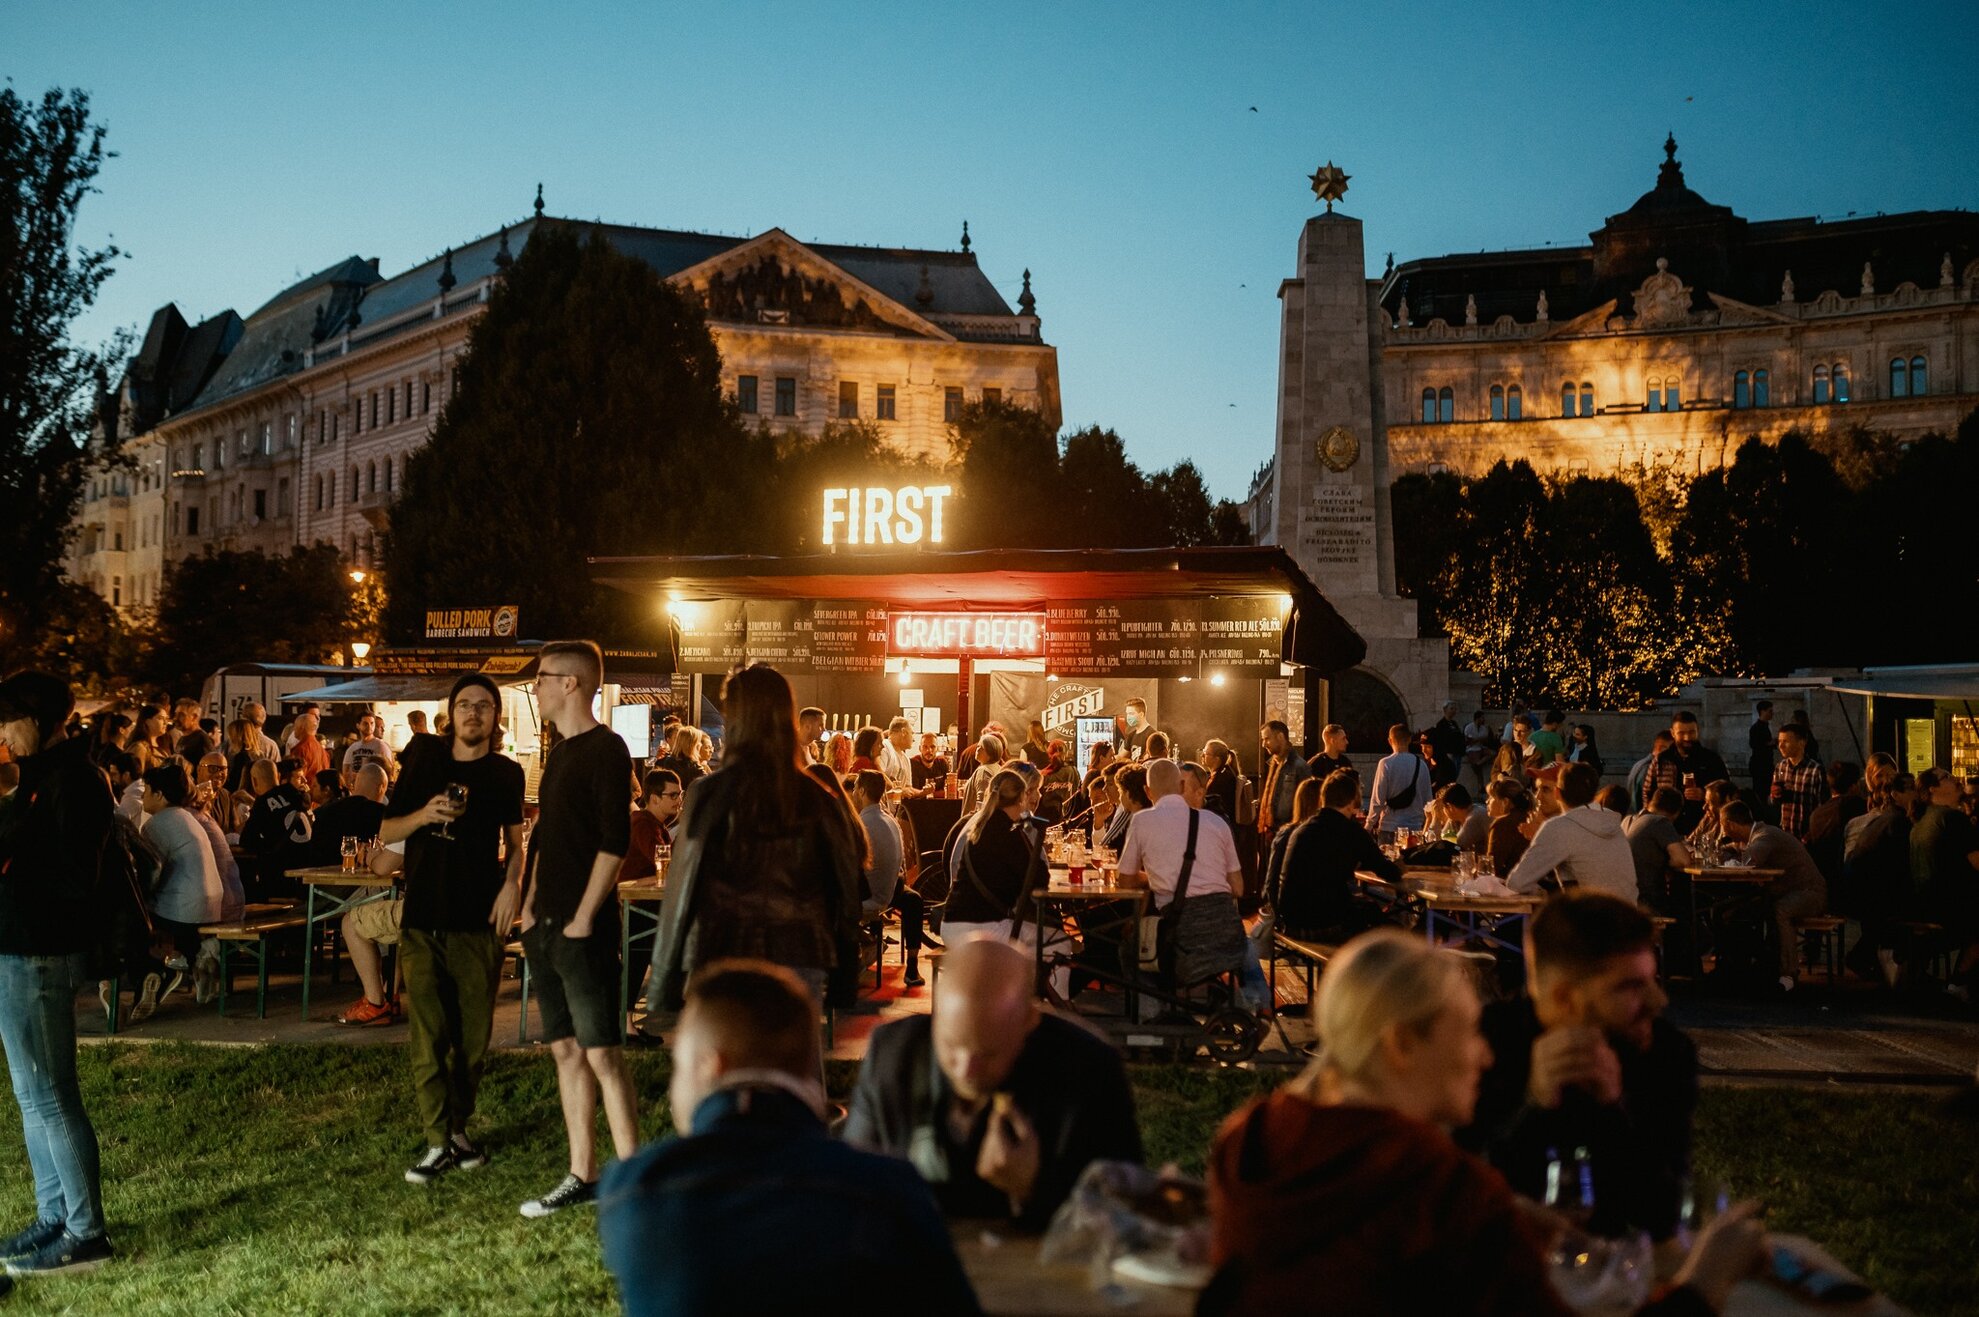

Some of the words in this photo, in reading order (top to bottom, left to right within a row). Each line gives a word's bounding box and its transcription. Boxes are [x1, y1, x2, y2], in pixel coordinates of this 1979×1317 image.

[822, 485, 951, 544] FIRST
[426, 611, 462, 629] PULLED
[463, 609, 492, 628] PORK
[426, 628, 456, 638] BARBECUE
[457, 627, 491, 637] SANDWICH
[895, 617, 972, 650] CRAFT
[974, 617, 1035, 650] BEER
[1046, 691, 1099, 730] FIRST
